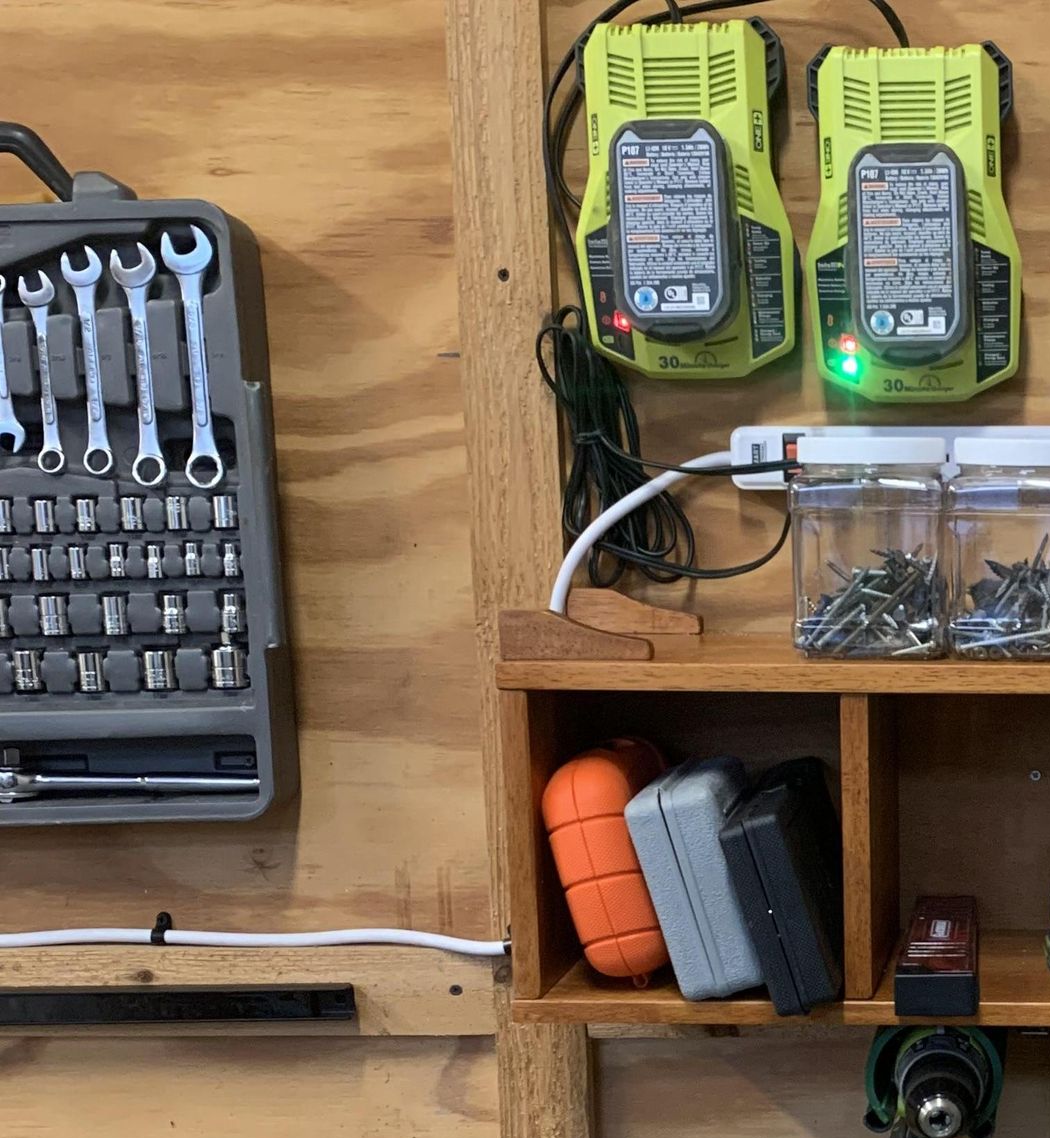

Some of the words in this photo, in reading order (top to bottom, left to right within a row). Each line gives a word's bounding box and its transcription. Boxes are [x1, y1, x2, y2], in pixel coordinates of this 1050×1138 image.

[621, 145, 640, 156] P107
[860, 168, 879, 179] P107
[658, 355, 680, 369] 30
[883, 378, 904, 392] 30
